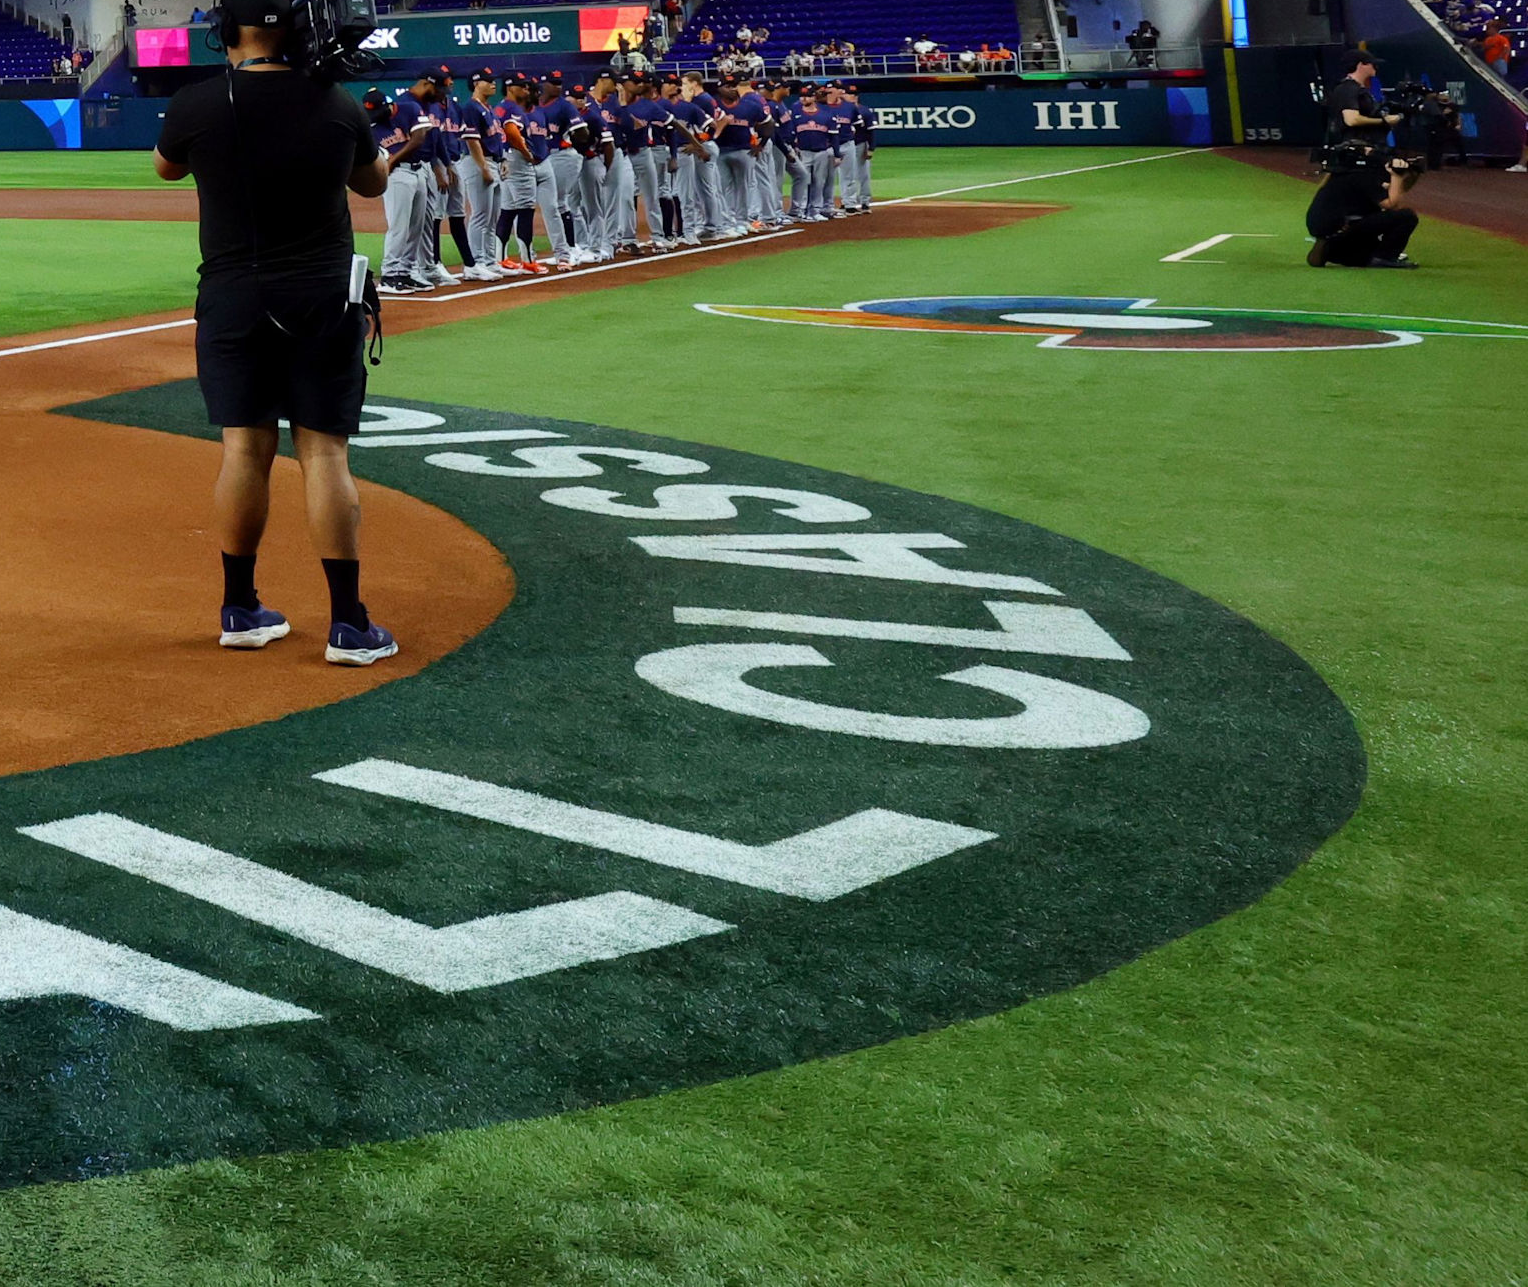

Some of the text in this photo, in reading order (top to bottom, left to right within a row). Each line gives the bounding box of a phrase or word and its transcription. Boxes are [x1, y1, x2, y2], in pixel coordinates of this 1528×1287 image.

[454, 21, 551, 45] T Mobile
[1033, 100, 1122, 131] IHI
[1246, 127, 1282, 141] 335
